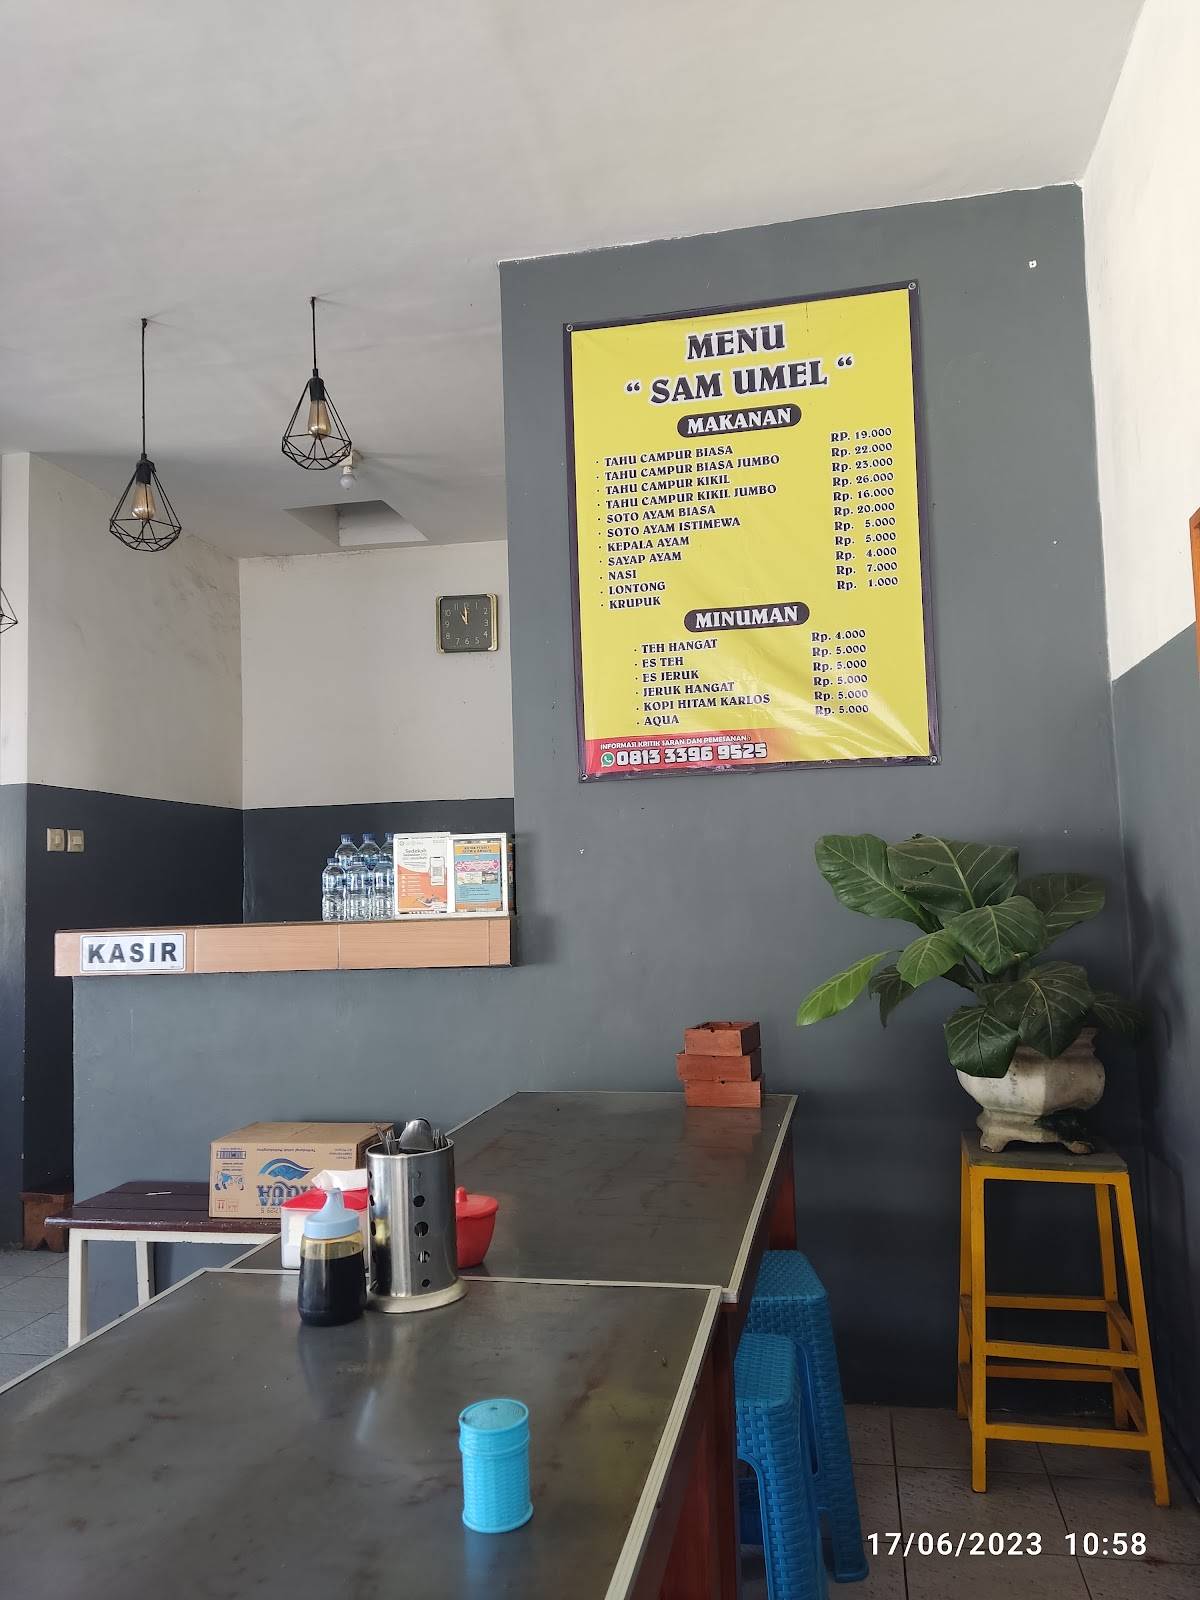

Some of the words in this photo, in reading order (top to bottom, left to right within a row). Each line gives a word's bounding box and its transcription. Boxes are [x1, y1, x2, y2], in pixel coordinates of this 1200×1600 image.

[687, 324, 786, 360] MENU
[650, 372, 722, 404] SAM
[733, 360, 828, 394] UMEL
[687, 407, 792, 434] MAKANAN
[604, 455, 637, 467] TAHU
[640, 449, 692, 464] CAMPUR
[696, 445, 734, 458] BIASA
[831, 432, 850, 442] RP.
[855, 427, 892, 440] 19.000
[605, 469, 637, 481] TAHU
[640, 464, 693, 478] CAMPUR
[696, 460, 734, 472] BIASA
[737, 455, 780, 468] JUMBO
[831, 447, 851, 458] Rp.
[854, 442, 892, 454] 22.000
[605, 484, 638, 495] TAHU
[641, 478, 693, 492] CAMPUR
[697, 474, 730, 487] KIKIL
[832, 462, 852, 472] Rp.
[855, 457, 893, 469] 23.000
[606, 497, 638, 509] TAHU
[641, 492, 694, 506] CAMPUR
[697, 489, 730, 501] KIKIL
[734, 484, 777, 498] JUMBO
[832, 477, 852, 488] Rp.
[856, 472, 894, 484] 26.000
[607, 512, 639, 524] SOTO
[642, 508, 675, 520] AYAM
[678, 505, 716, 517] BIASA
[833, 492, 853, 502] Rp.
[858, 487, 894, 499] 16.000
[607, 526, 639, 538] SOTO
[642, 522, 675, 534] AYAM
[679, 517, 741, 531] ISTIMEWA
[834, 506, 854, 516] Rp.
[857, 502, 895, 514] 20.000
[607, 539, 654, 552] KEPALA
[657, 536, 690, 548] AYAM
[834, 521, 854, 531] Rp.
[865, 517, 896, 528] 5.000
[608, 554, 646, 566] SAYAP
[649, 551, 682, 563] AYAM
[835, 536, 855, 546] Rp.
[865, 532, 896, 542] 5.000
[608, 570, 637, 581] NASI
[836, 551, 855, 561] Rp.
[866, 547, 897, 558] 4.000
[609, 581, 666, 595] LONTONG
[836, 565, 856, 576] Rp.
[867, 562, 898, 572] 7.000
[609, 596, 661, 609] KRUPUK
[837, 580, 856, 590] Rp.
[868, 577, 898, 587] 1.000
[695, 605, 798, 629] MINUMAN
[642, 644, 665, 654] TEH
[669, 638, 718, 652] HANGAT
[811, 632, 831, 642] Rp.
[835, 629, 866, 640] 4.000
[642, 658, 657, 668] ES
[660, 656, 684, 667] TEH
[812, 647, 832, 658] Rp.
[836, 644, 866, 655] 5.000
[642, 673, 657, 683] ES
[661, 670, 700, 682] JERUK
[813, 662, 832, 672] Rp.
[836, 659, 867, 670] 5.000
[643, 685, 681, 697] JERUK
[684, 682, 735, 695] HANGAT
[813, 676, 833, 687] Rp.
[837, 674, 868, 685] 5.000
[644, 700, 674, 712] KOPI
[678, 697, 716, 709] HITAM
[720, 694, 770, 706] KARLOS
[814, 691, 834, 701] Rp.
[838, 689, 868, 700] 5.000
[644, 714, 680, 727] AQUA
[815, 706, 835, 716] Rp.
[839, 704, 869, 714] 5.000
[600, 742, 637, 750] INFORMASI
[638, 740, 660, 748] KRITIK
[616, 749, 660, 766] 0813
[664, 746, 713, 763] 3396
[718, 742, 767, 760] 9525
[88, 942, 178, 964] KASIR
